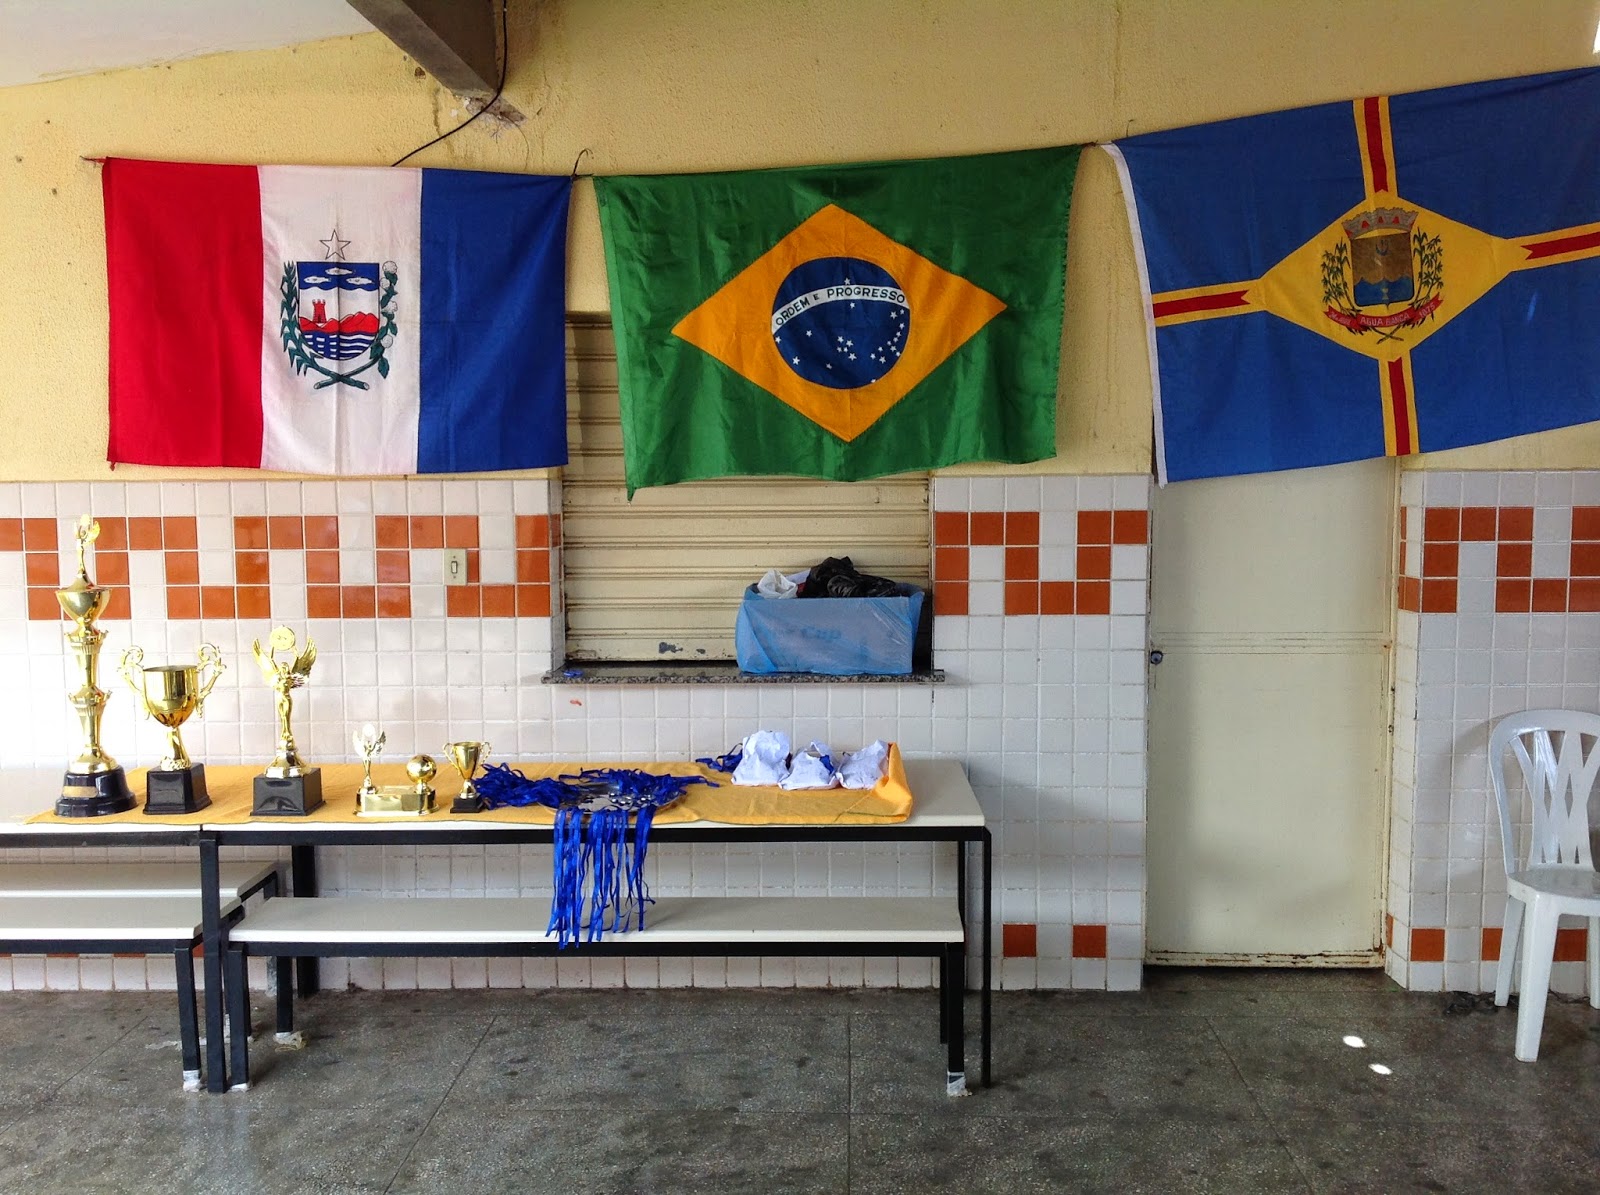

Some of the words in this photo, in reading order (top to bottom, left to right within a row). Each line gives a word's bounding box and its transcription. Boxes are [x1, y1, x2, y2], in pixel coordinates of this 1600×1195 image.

[775, 297, 811, 326] ORDEM
[813, 293, 820, 301] E
[827, 287, 905, 304] PROGRESSO
